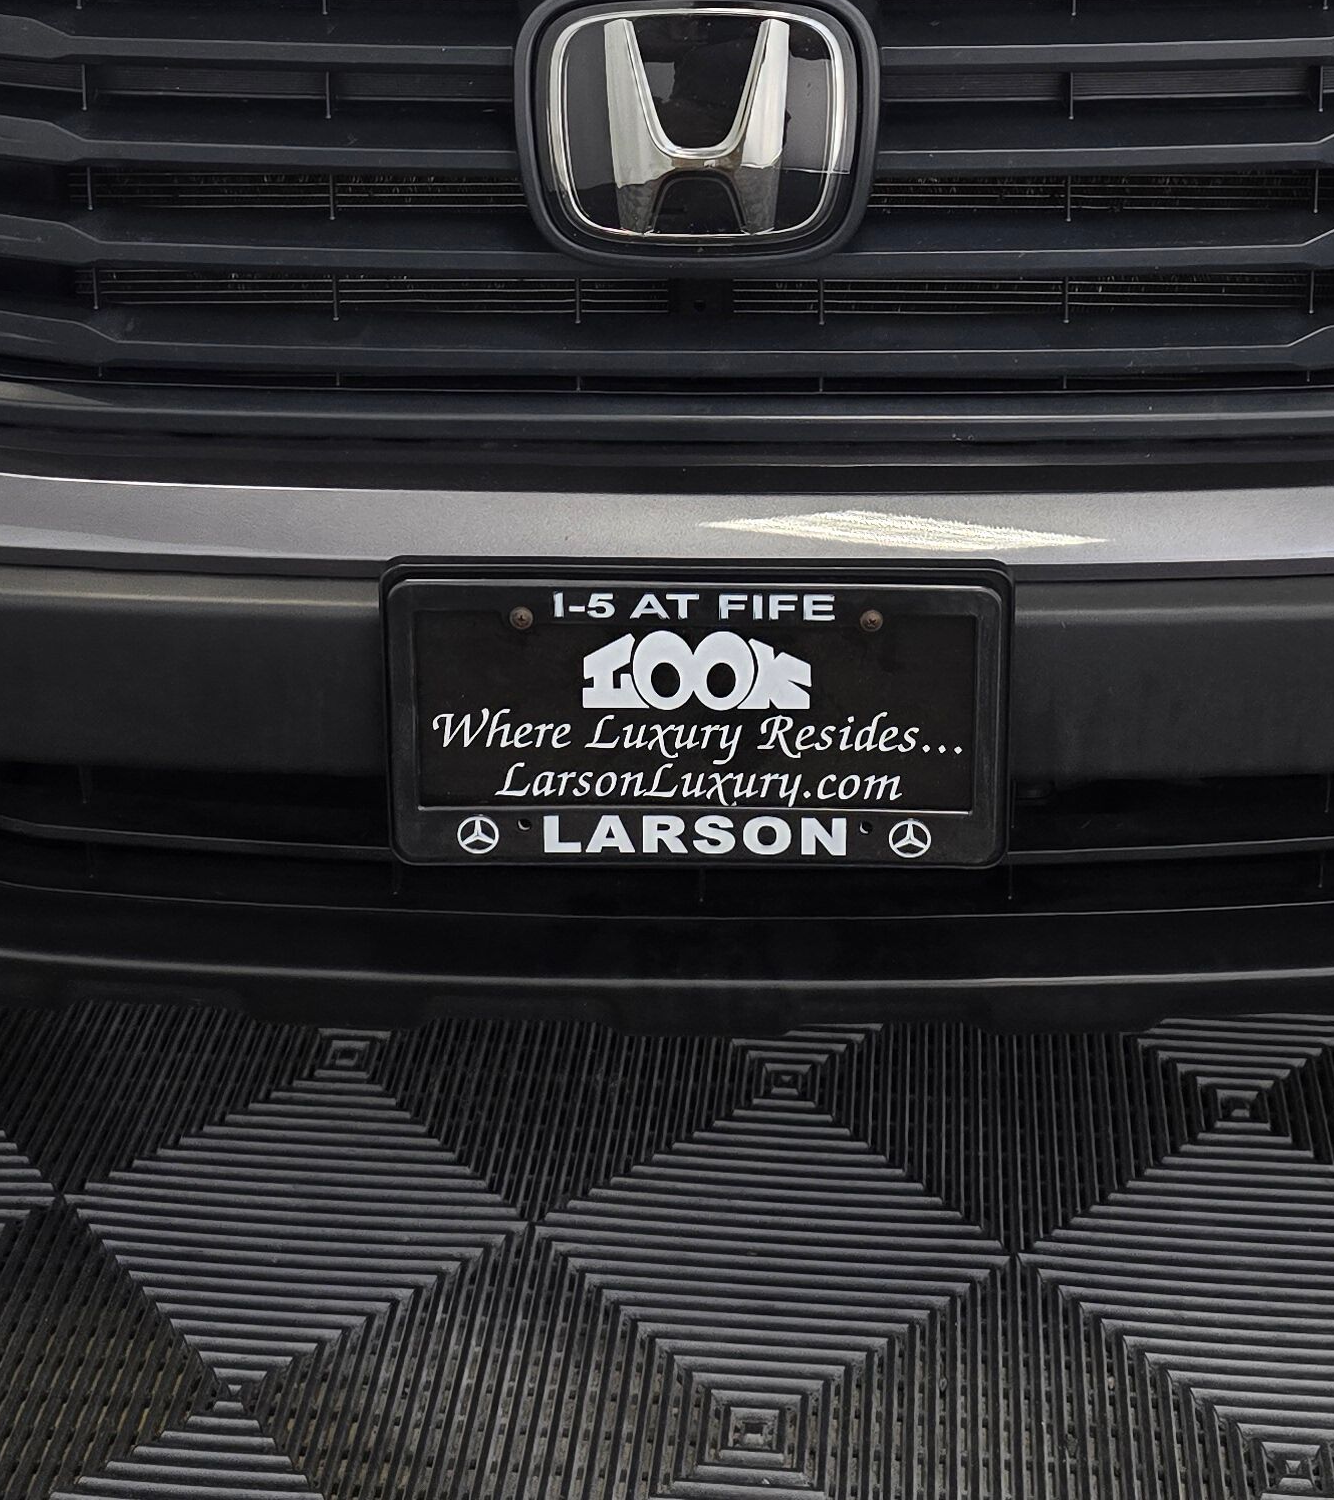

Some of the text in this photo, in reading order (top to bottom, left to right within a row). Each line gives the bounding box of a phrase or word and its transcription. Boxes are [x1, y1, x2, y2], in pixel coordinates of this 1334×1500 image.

[553, 592, 836, 622] I-5 AT FIFE
[582, 630, 813, 711] LOOK
[432, 708, 965, 763] Where Luxury Resides...
[494, 762, 903, 807] LarsonLuxury.com
[543, 814, 848, 857] LARSON
